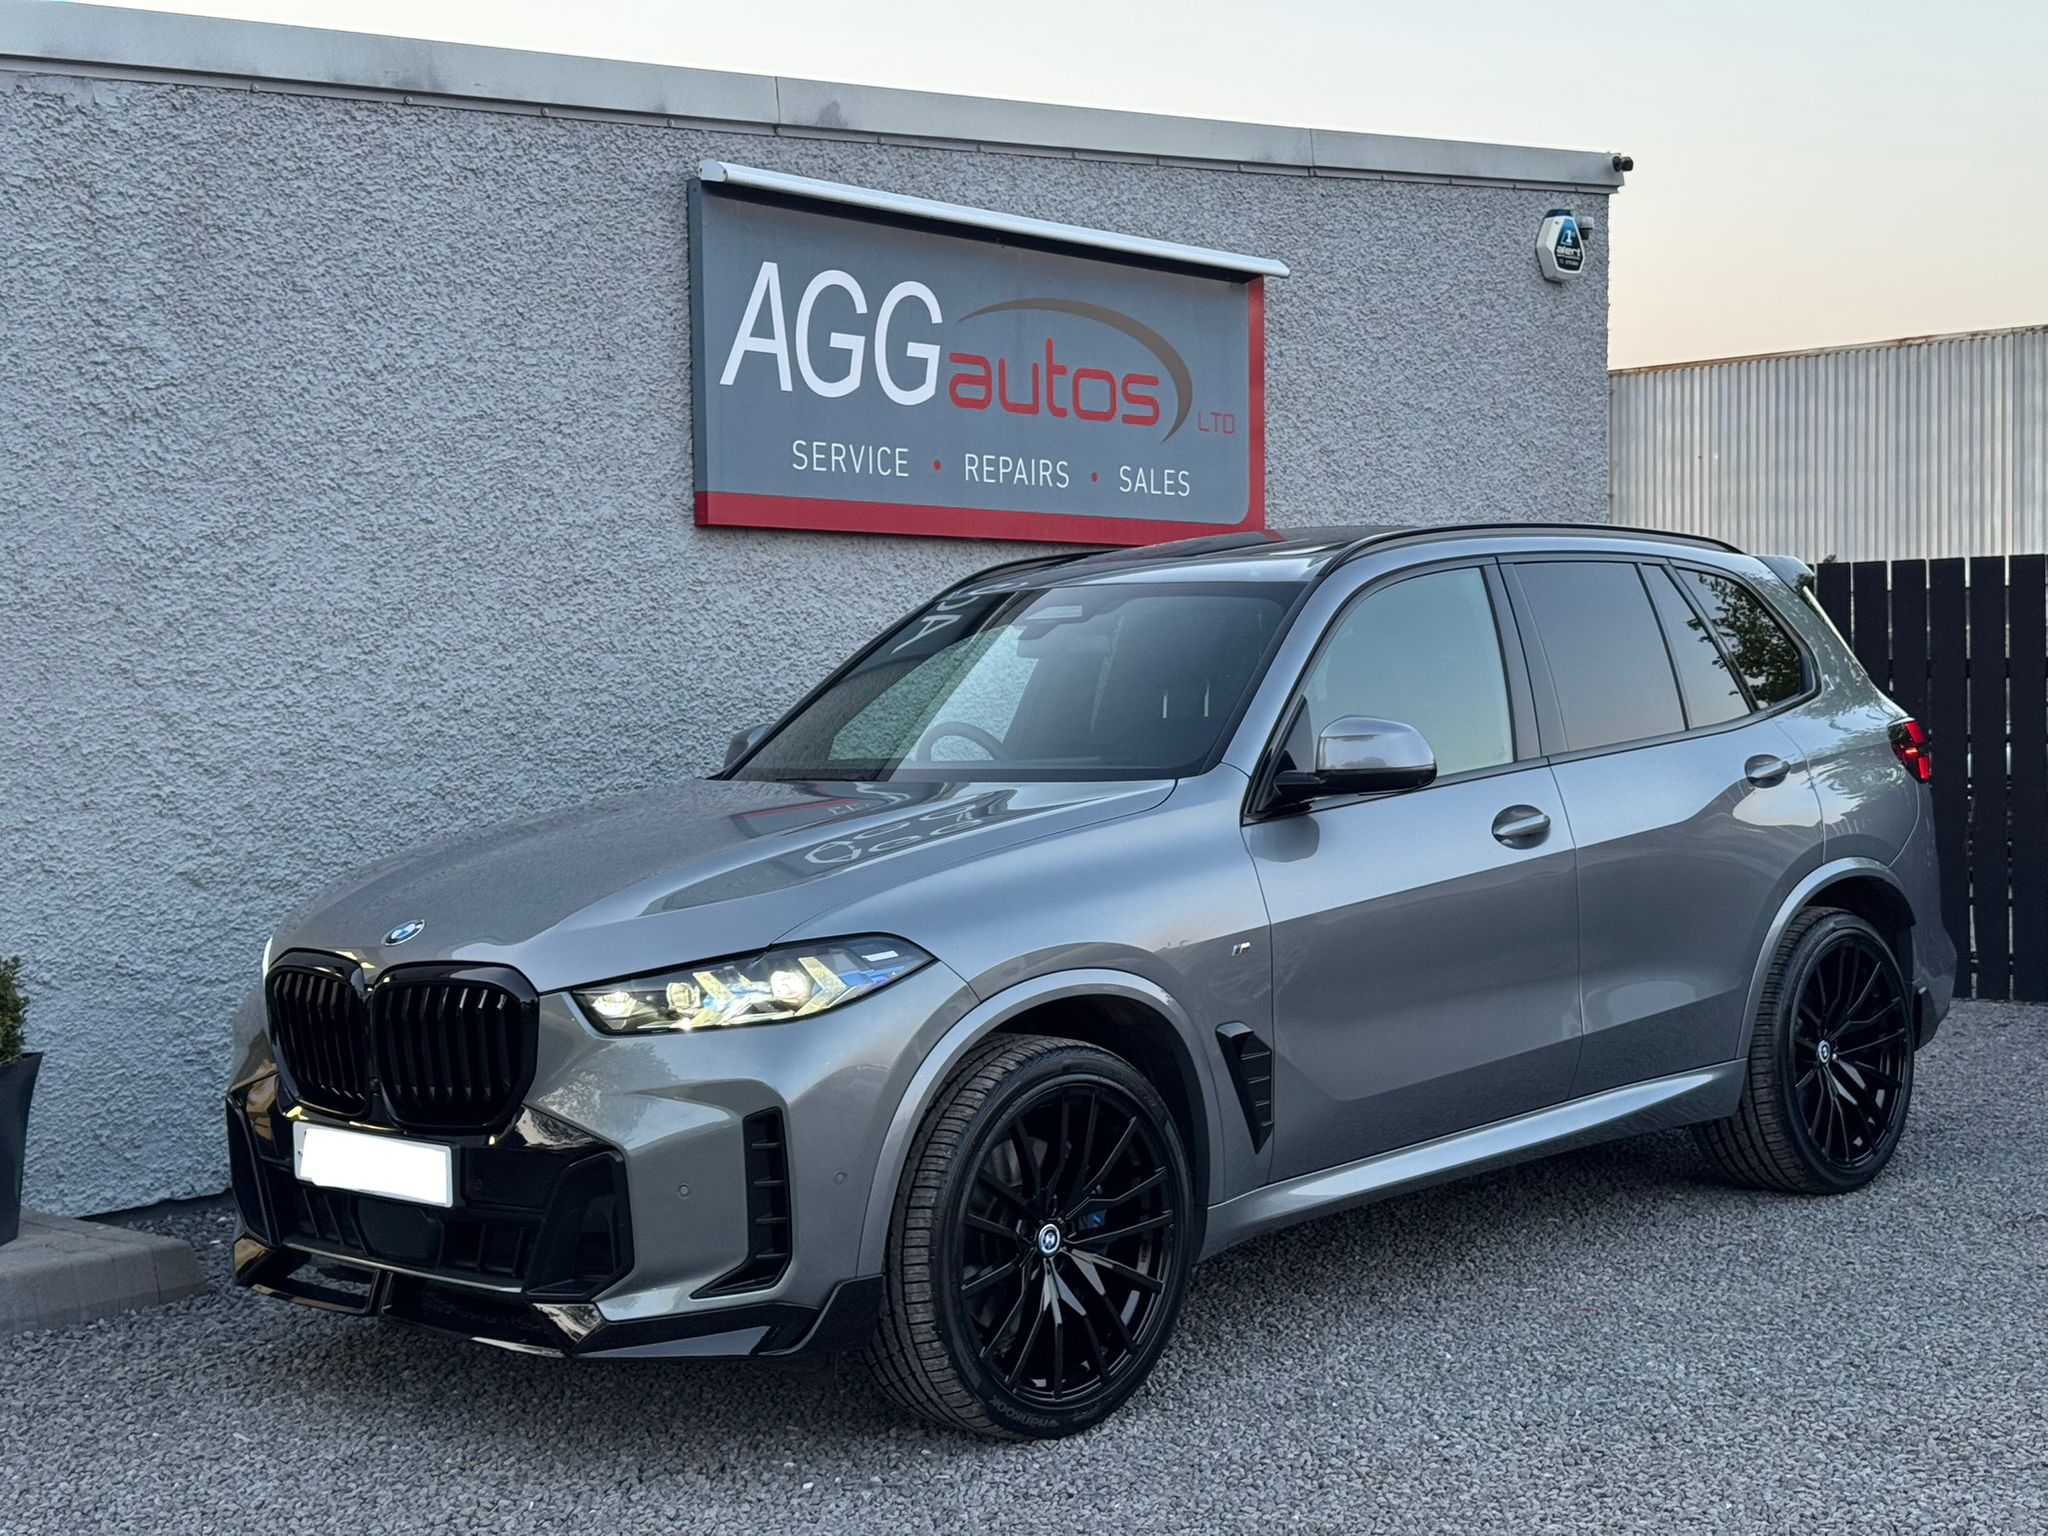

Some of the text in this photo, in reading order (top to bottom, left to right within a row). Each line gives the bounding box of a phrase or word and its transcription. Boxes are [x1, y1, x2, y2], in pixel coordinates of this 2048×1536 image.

[719, 261, 1235, 435] AGG autos LTD
[792, 440, 1191, 497] SERVICE REPAIRS SALES
